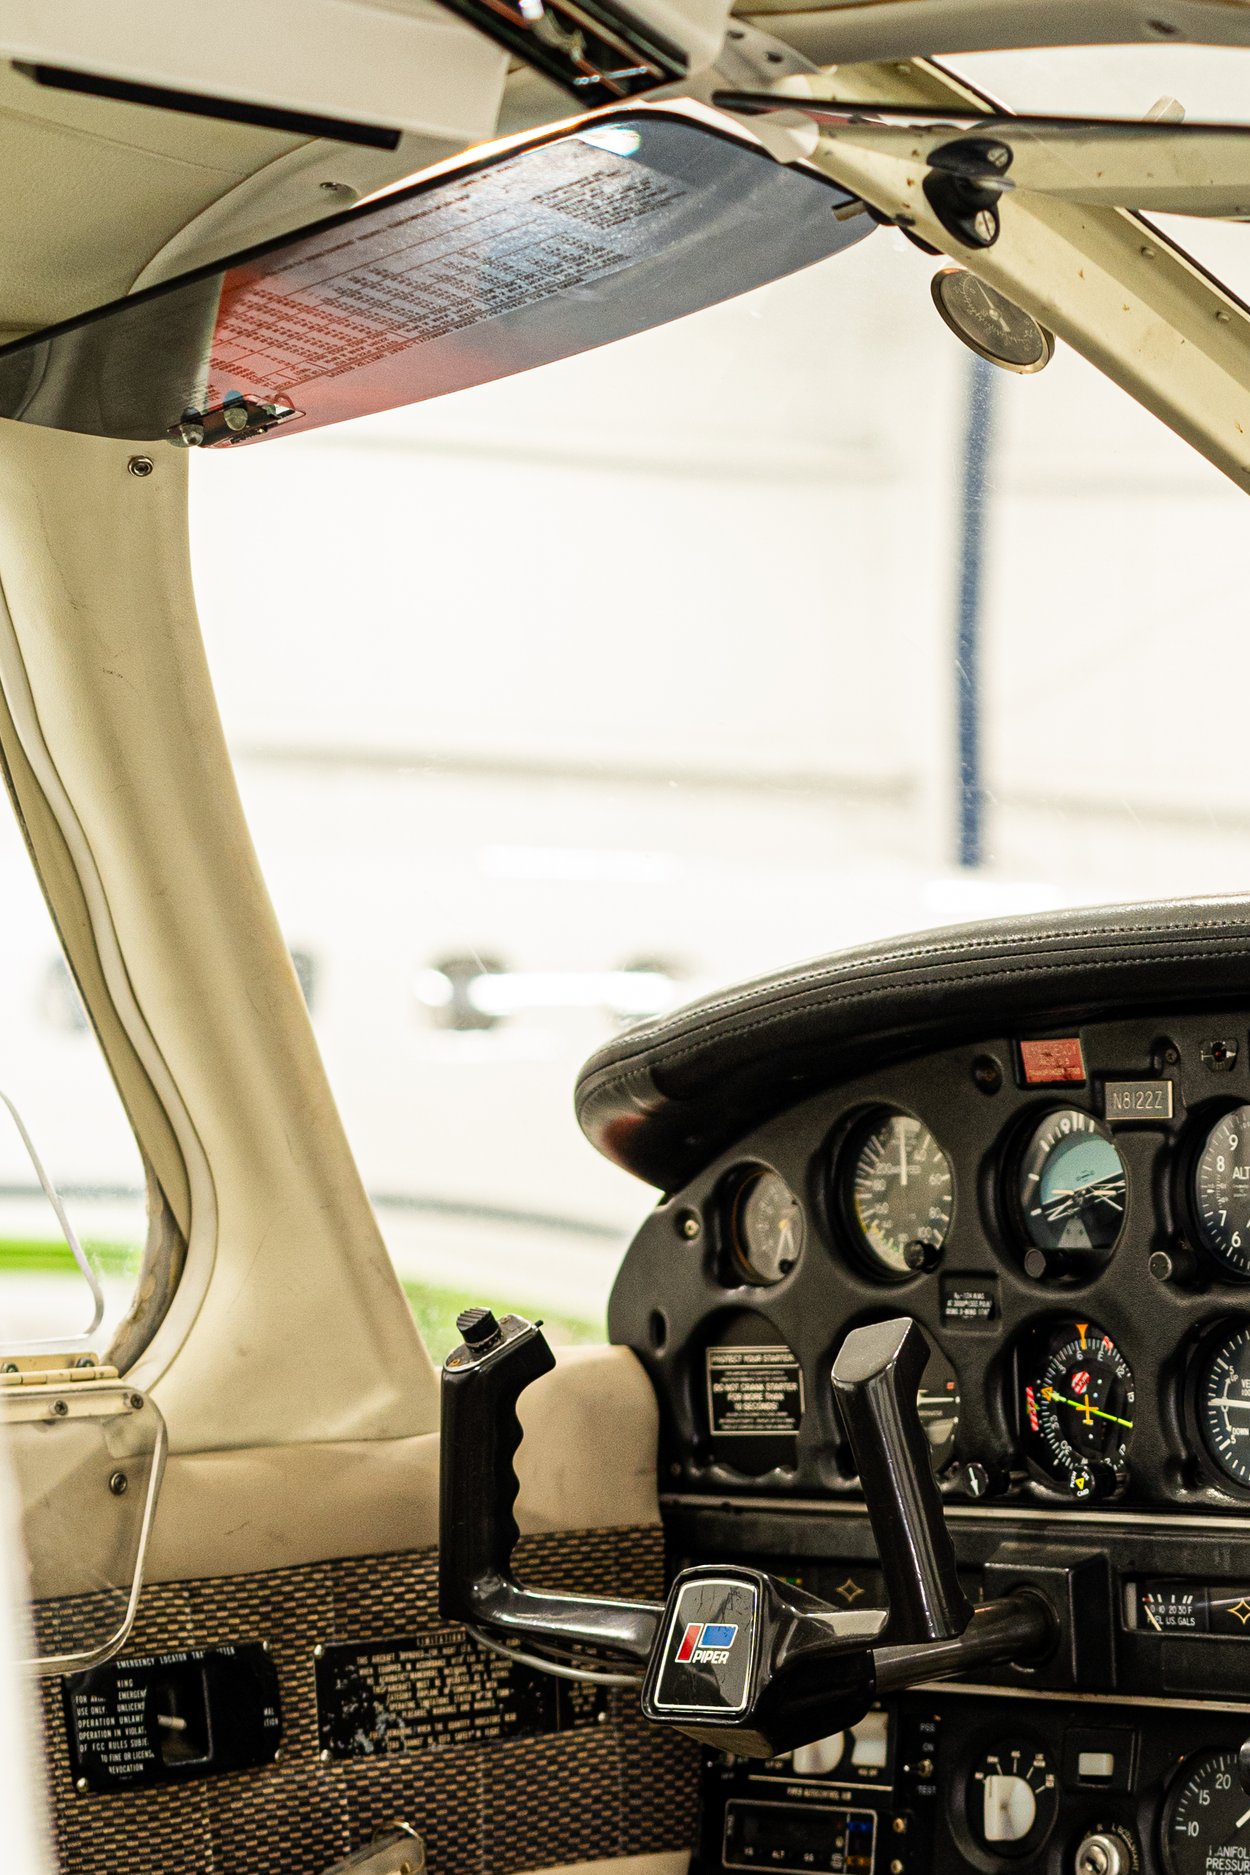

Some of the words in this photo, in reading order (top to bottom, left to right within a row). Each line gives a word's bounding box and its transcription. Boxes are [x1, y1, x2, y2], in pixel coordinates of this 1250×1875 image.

[1113, 1090, 1162, 1110] N8122Z
[1228, 1134, 1239, 1151] 9
[1216, 1155, 1225, 1172] 8
[1232, 1166, 1250, 1180] ALT
[1218, 1209, 1228, 1227] 7
[1231, 1231, 1242, 1248] 6
[116, 1658, 155, 1669] EMERGENCY
[160, 1653, 188, 1665] LOCATOR
[692, 1650, 730, 1665] PIPER
[78, 1730, 112, 1741] OPERATION
[114, 1728, 122, 1737] IN
[79, 1743, 88, 1752] OF
[92, 1742, 105, 1751] FCC
[108, 1739, 128, 1750] RULES
[101, 1753, 109, 1762] TO
[109, 1753, 122, 1762] FINE
[124, 1751, 132, 1760] OR
[108, 1763, 144, 1775] REVOCATION
[1215, 1773, 1231, 1789] 20
[1199, 1789, 1211, 1806] 15
[1187, 1821, 1199, 1837] 10
